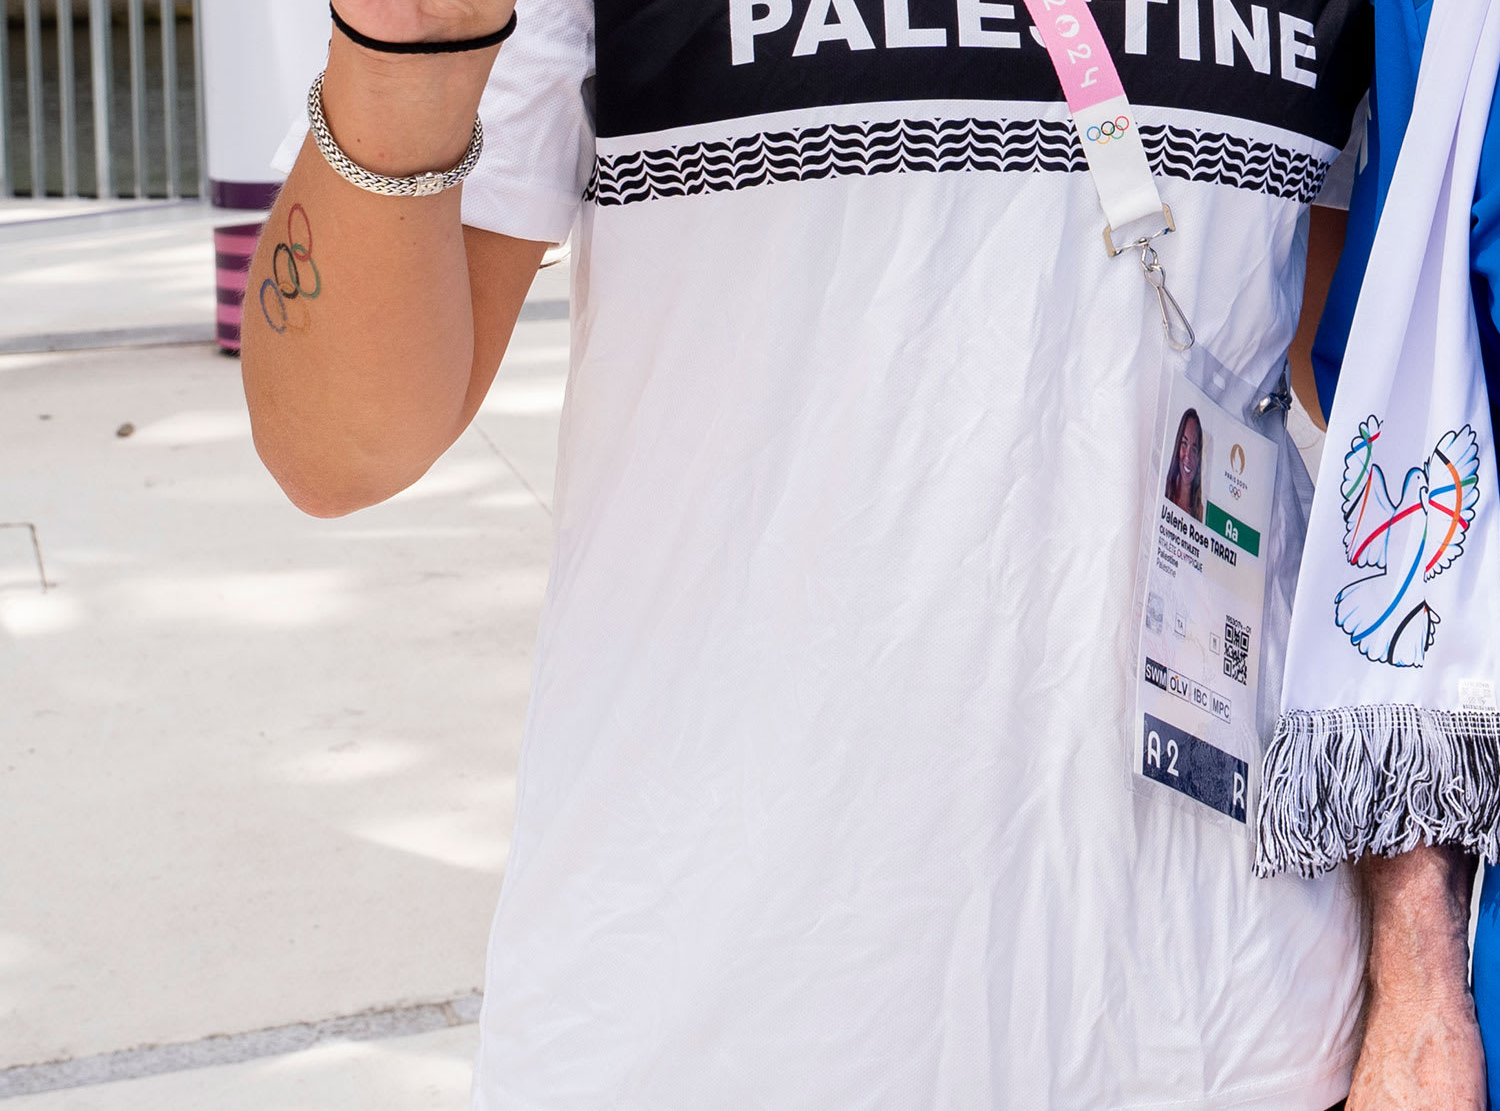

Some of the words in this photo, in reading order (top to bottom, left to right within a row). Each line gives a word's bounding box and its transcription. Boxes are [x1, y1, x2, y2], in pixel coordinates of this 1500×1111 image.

[1161, 504, 1188, 535] Valerie
[1189, 524, 1209, 549] Rose
[1210, 537, 1238, 567] TARAZI
[1225, 520, 1239, 542] Aa
[1145, 663, 1167, 690] SWM
[1169, 676, 1188, 697] OLV
[1193, 687, 1208, 708] IBC
[1212, 698, 1230, 719] MPC
[1233, 771, 1246, 810] R
